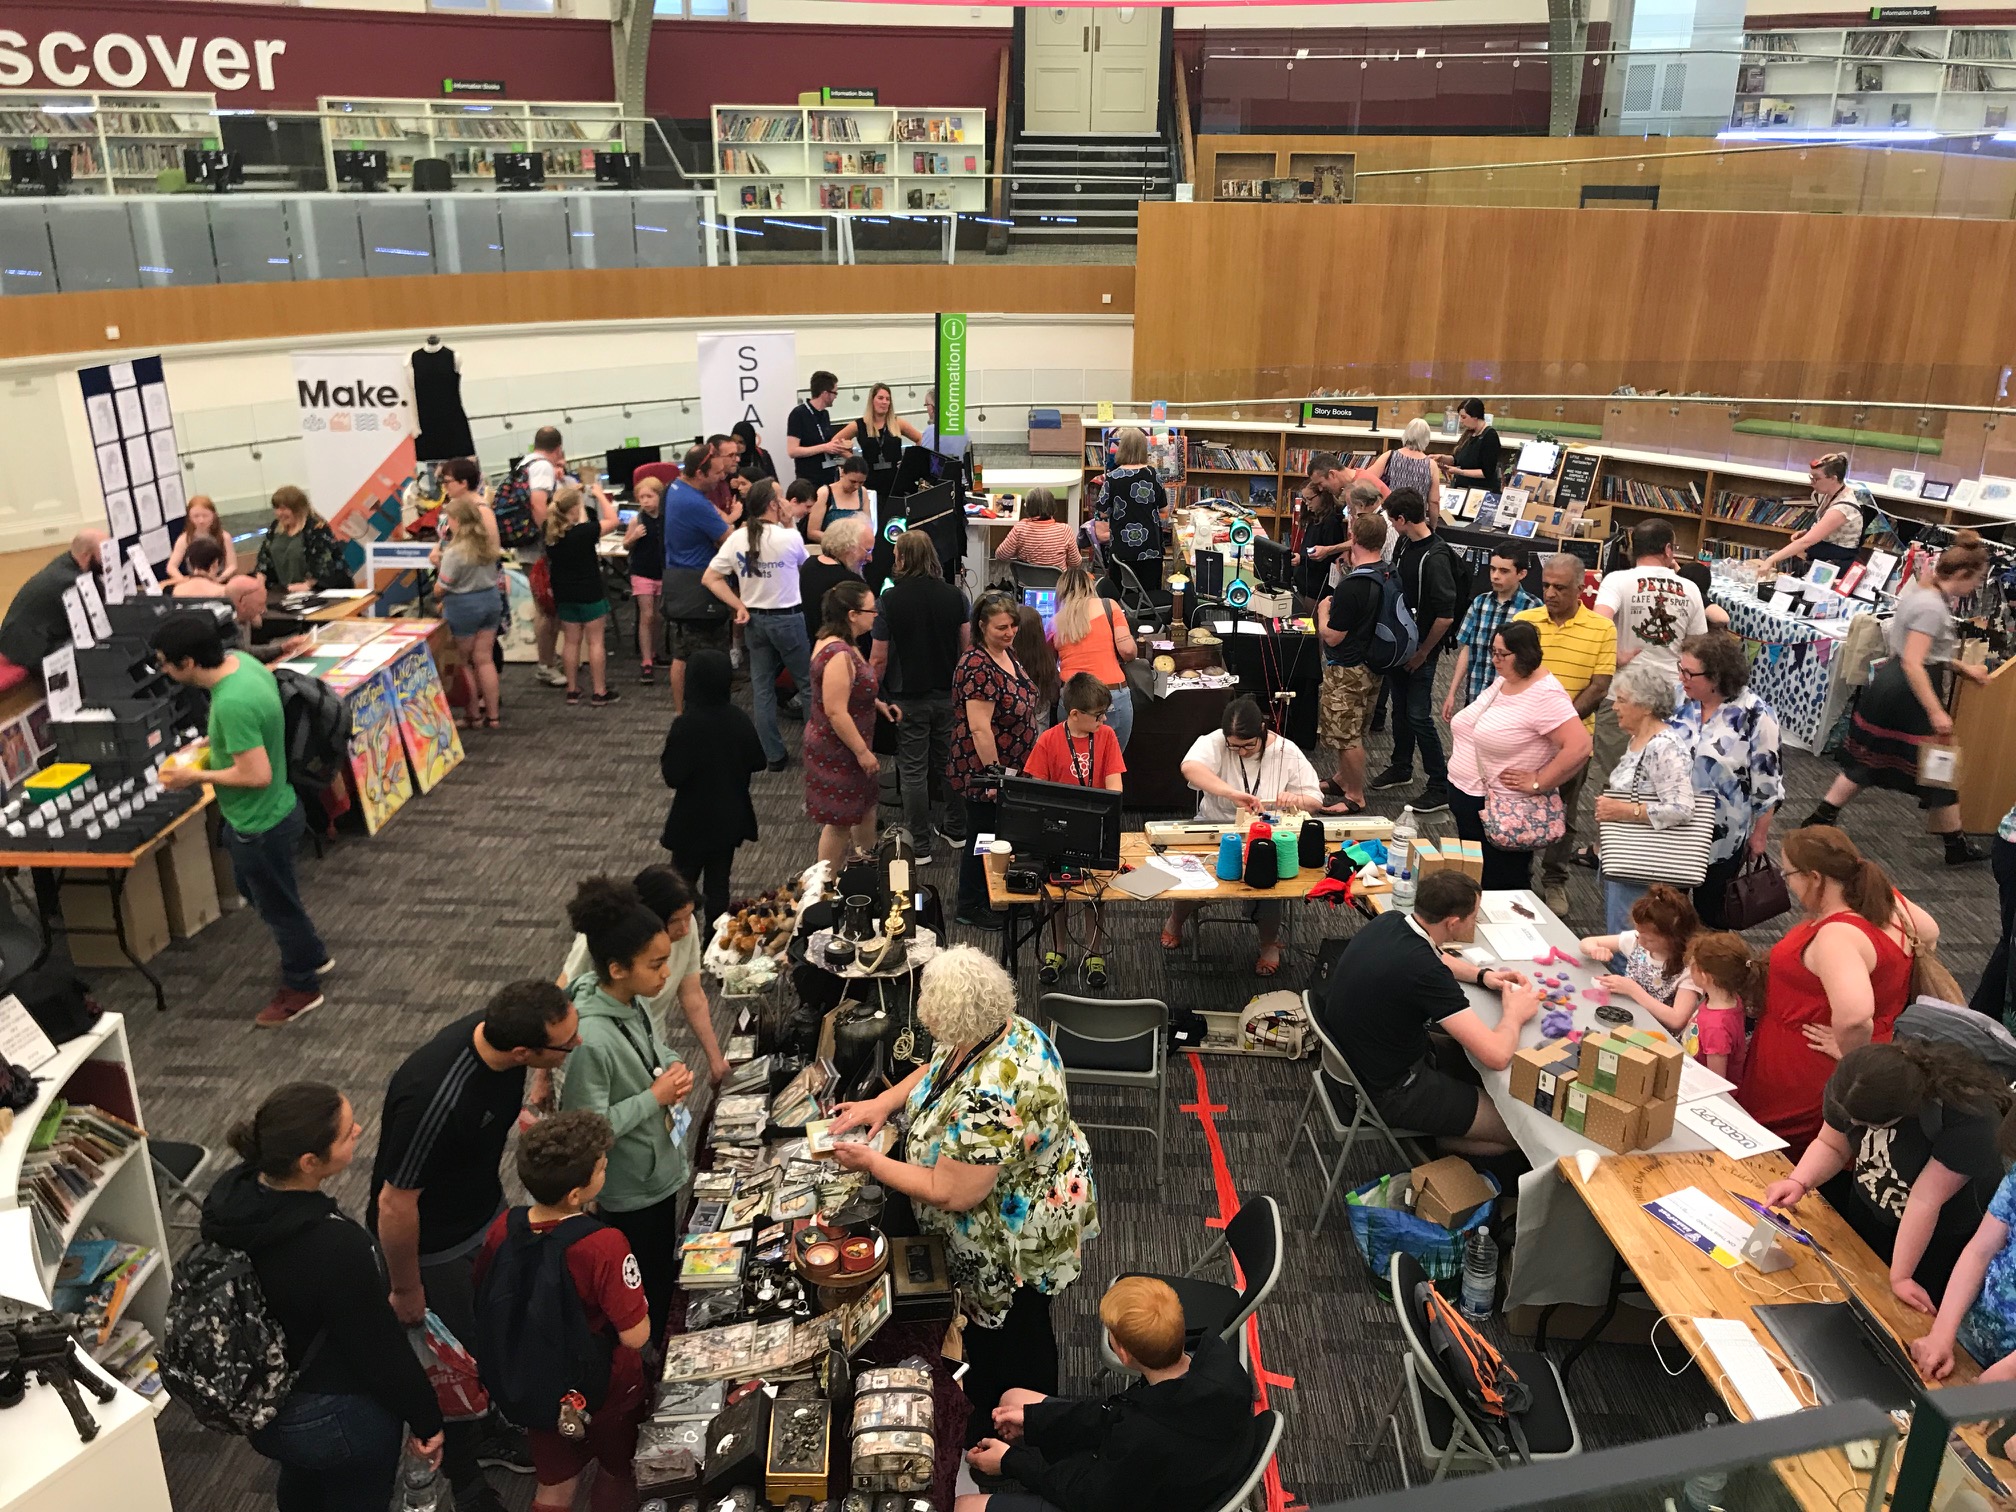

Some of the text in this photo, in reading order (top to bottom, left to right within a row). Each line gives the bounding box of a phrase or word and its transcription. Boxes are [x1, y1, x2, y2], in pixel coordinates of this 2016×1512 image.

[297, 379, 408, 408] Make.
[945, 342, 961, 432] Information
[1314, 407, 1352, 416] Story Books
[1637, 577, 1686, 597] PETER
[1670, 598, 1690, 607] SPORT
[1690, 1107, 1758, 1149] UCRAFT
